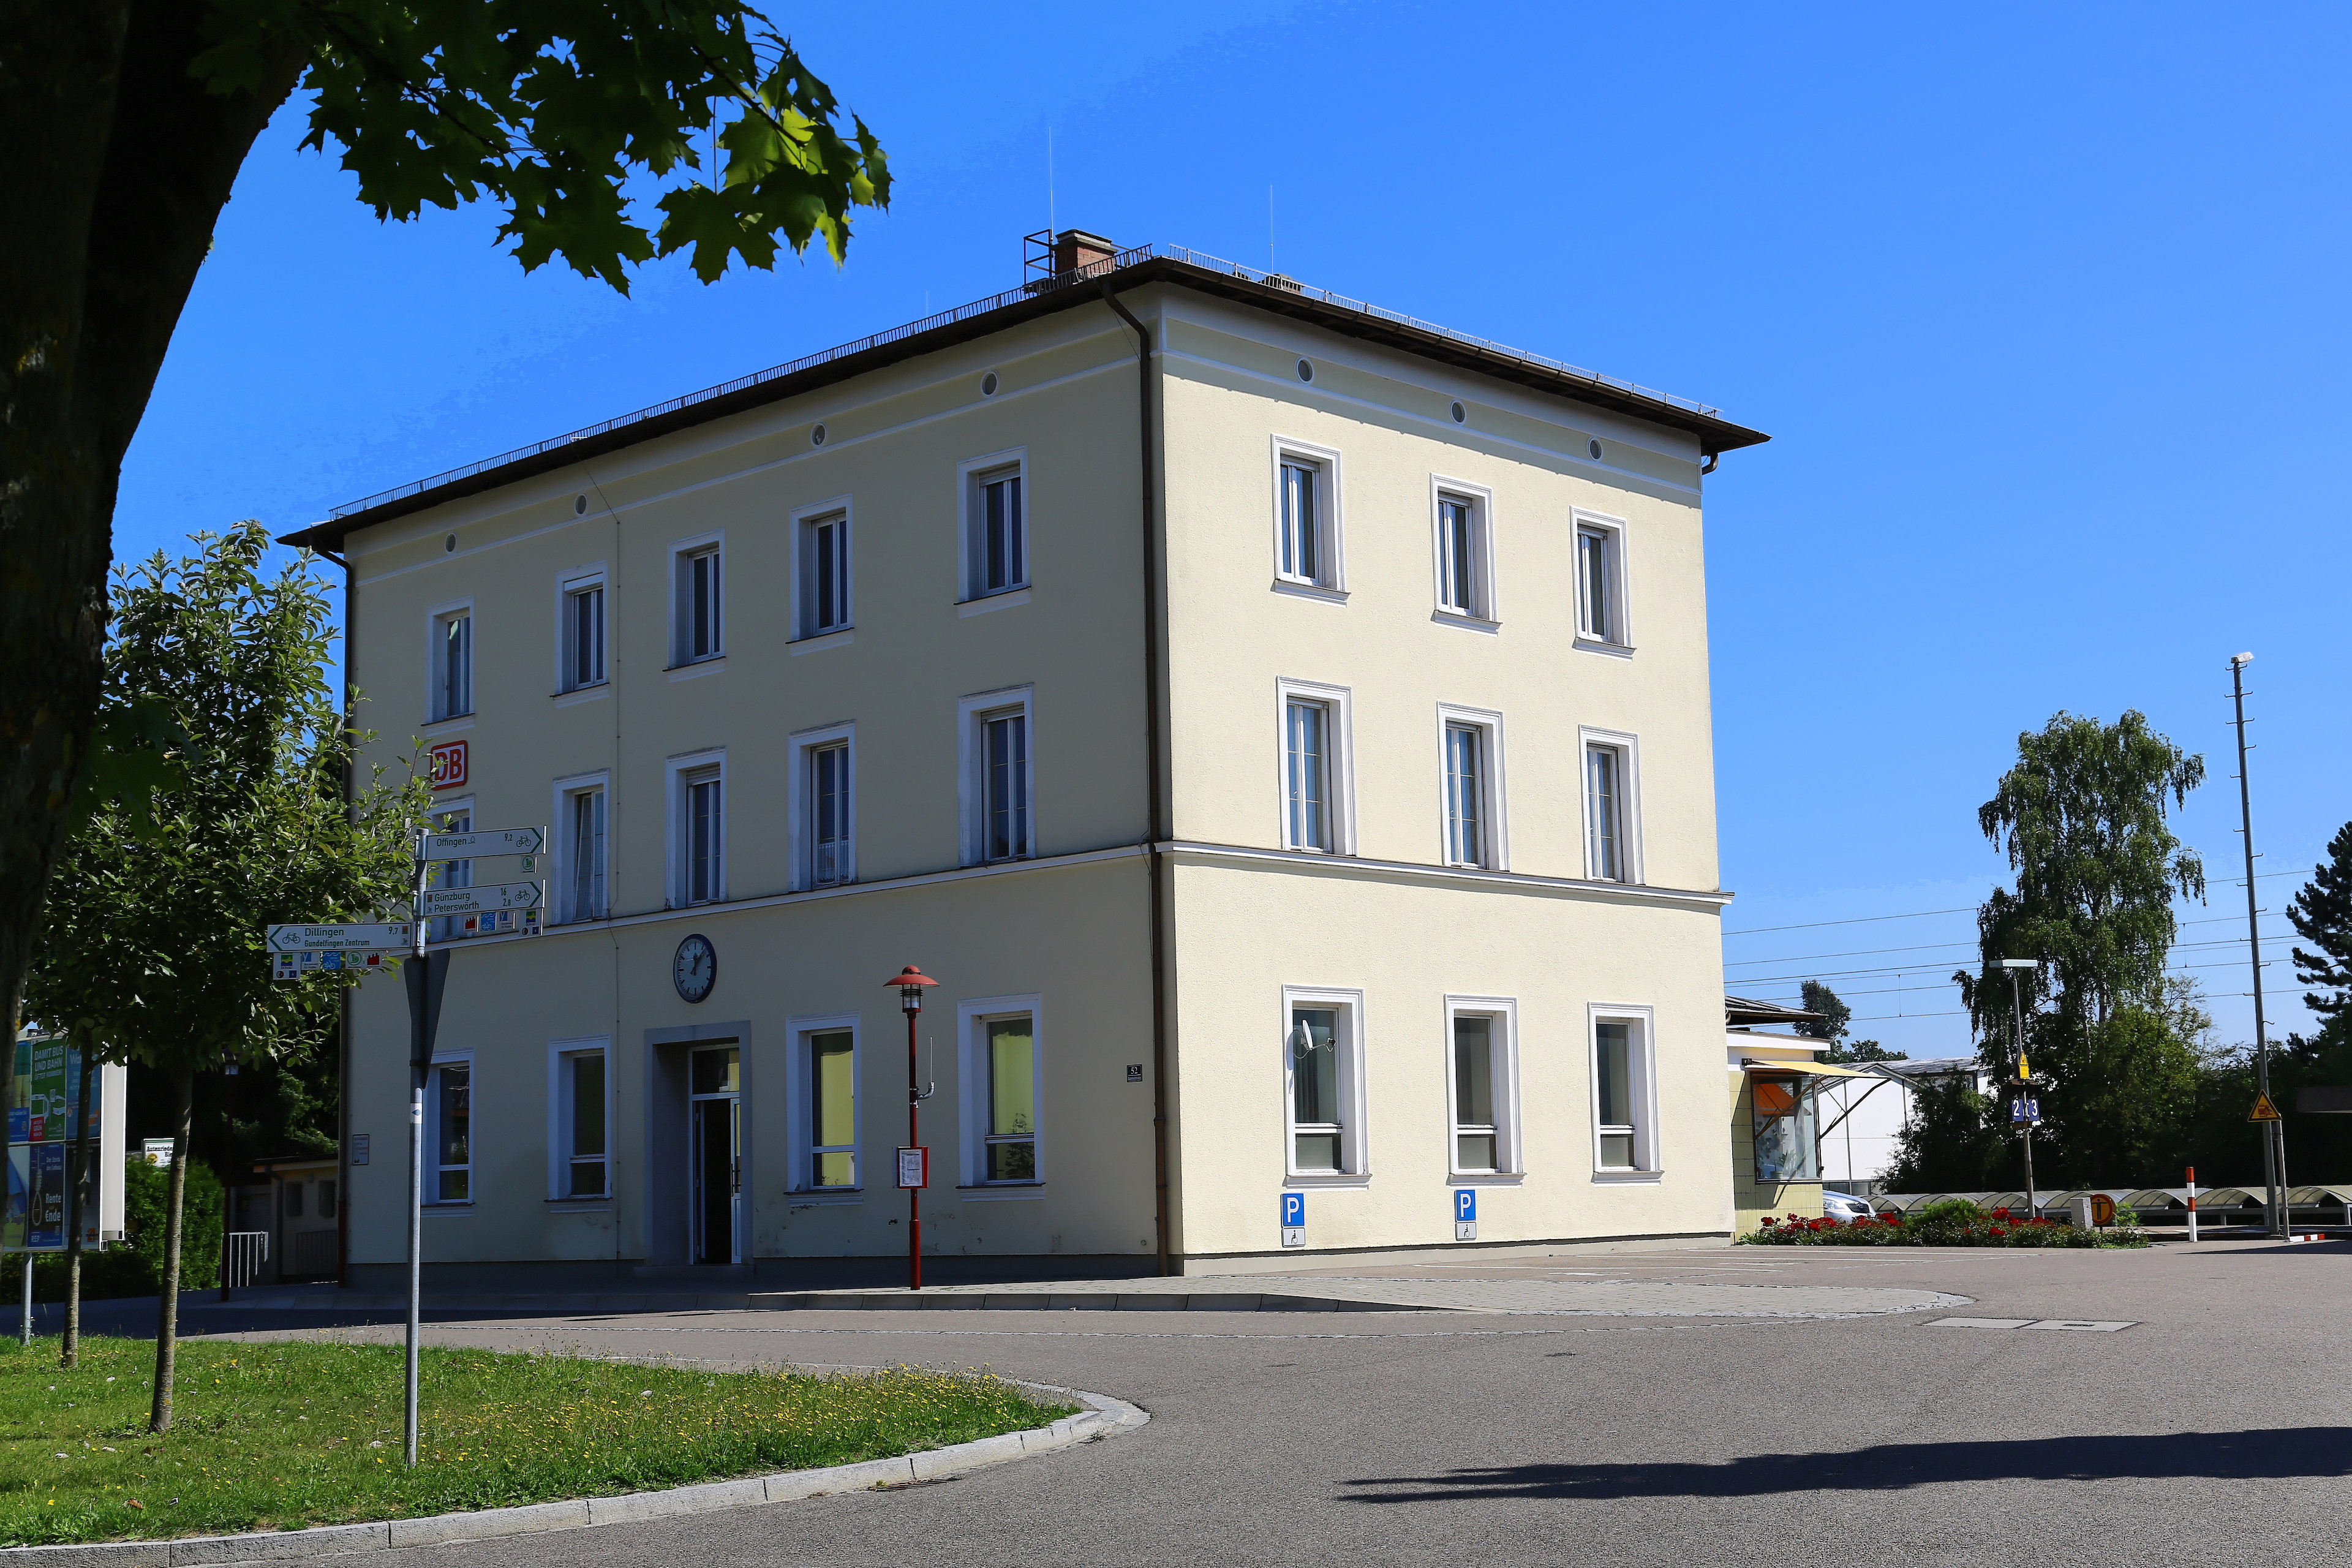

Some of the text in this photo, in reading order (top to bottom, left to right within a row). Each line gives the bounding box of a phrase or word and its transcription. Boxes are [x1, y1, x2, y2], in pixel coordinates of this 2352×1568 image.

[433, 747, 464, 783] DB
[437, 838, 467, 848] Offingen
[434, 888, 507, 902] Günzburg 16
[434, 902, 479, 913] Peterswörth
[304, 928, 344, 938] Dillingen
[34, 1046, 63, 1060] DAMIT BUS
[35, 1057, 62, 1071] UND BAHN
[2013, 1099, 2038, 1117] 2 3
[45, 1193, 61, 1204] Rente
[1460, 1193, 1471, 1218] P
[1286, 1196, 1299, 1223] P
